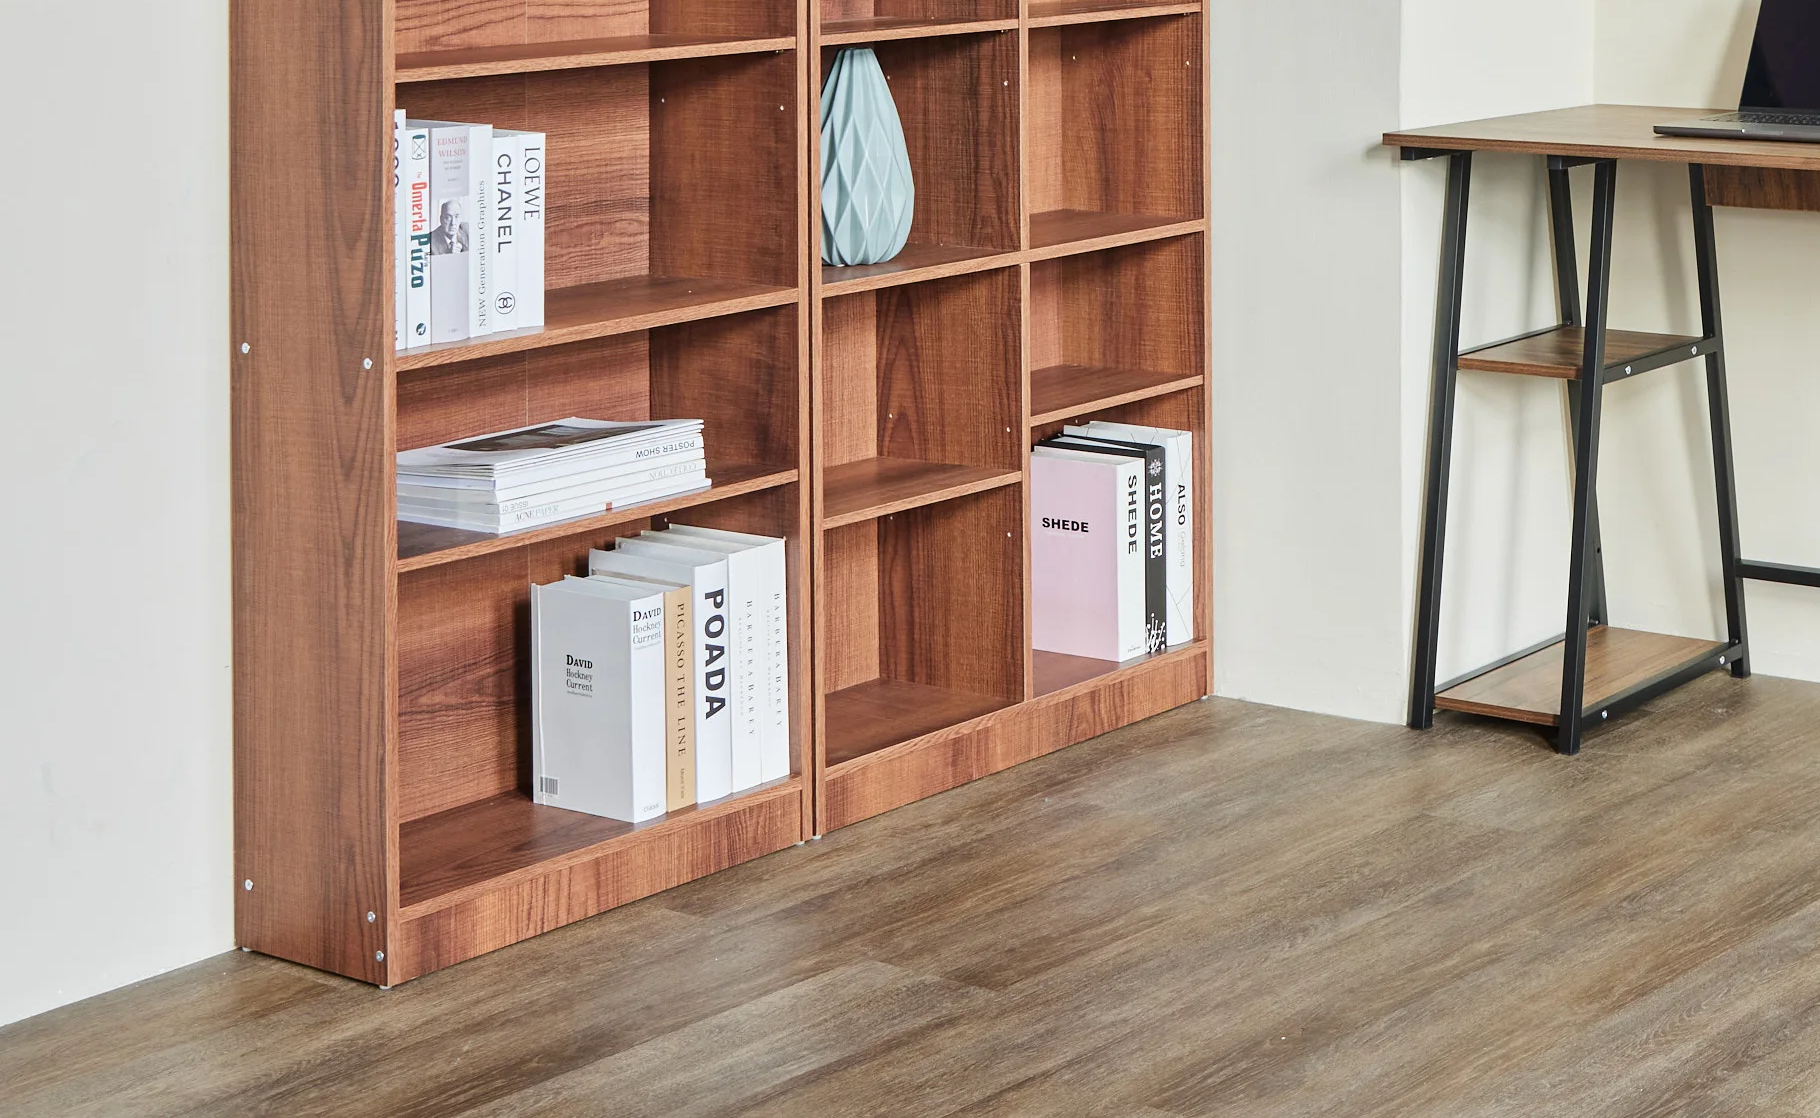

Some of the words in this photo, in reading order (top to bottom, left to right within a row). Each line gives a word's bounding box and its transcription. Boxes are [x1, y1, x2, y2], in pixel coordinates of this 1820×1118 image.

[437, 135, 468, 145] EDMUND
[438, 148, 467, 157] WILSON
[523, 146, 542, 221] LOEWE
[411, 181, 428, 232] Omerta
[477, 180, 487, 230] Graphics
[497, 153, 512, 254] CHANEL
[410, 231, 430, 289] Puzo
[478, 233, 486, 295] Generation
[479, 298, 487, 328] NEW
[635, 444, 661, 459] SHOW
[662, 439, 696, 455] POSTER
[515, 509, 535, 522] ACNE
[1128, 475, 1138, 555] SHEDE
[1149, 482, 1163, 559] HOME
[1177, 484, 1186, 526] ALSO
[1042, 517, 1089, 533] SHEDE
[633, 607, 662, 622] DAVID
[633, 620, 662, 634] Hockney
[632, 631, 662, 645] Current
[676, 602, 685, 669] PICASSO
[566, 654, 593, 669] DAVID
[704, 587, 726, 720] POADA
[566, 668, 593, 683] Hockney
[566, 678, 593, 692] Current
[677, 673, 685, 709] THE
[677, 717, 687, 757] LINE
